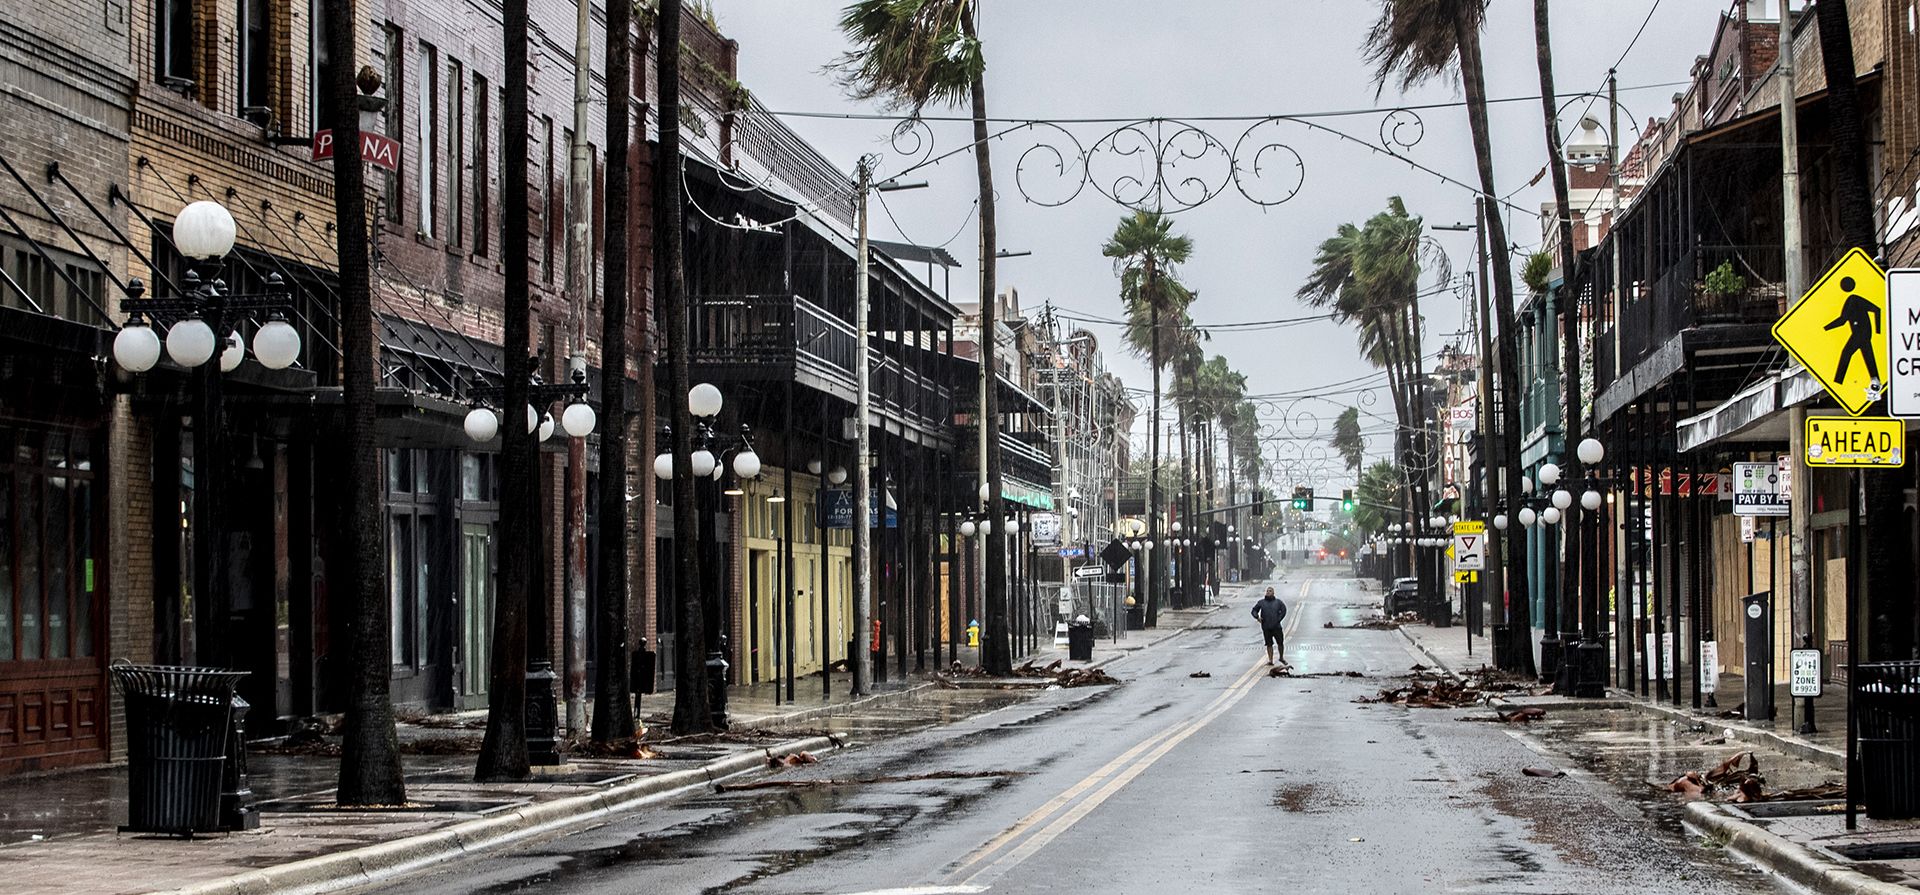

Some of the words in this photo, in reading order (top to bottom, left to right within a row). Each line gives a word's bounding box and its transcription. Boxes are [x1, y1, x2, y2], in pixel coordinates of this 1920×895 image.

[318, 134, 394, 166] PNA
[1821, 431, 1892, 453] AHEAD
[1738, 494, 1757, 504] PAY
[1760, 494, 1773, 504] BY
